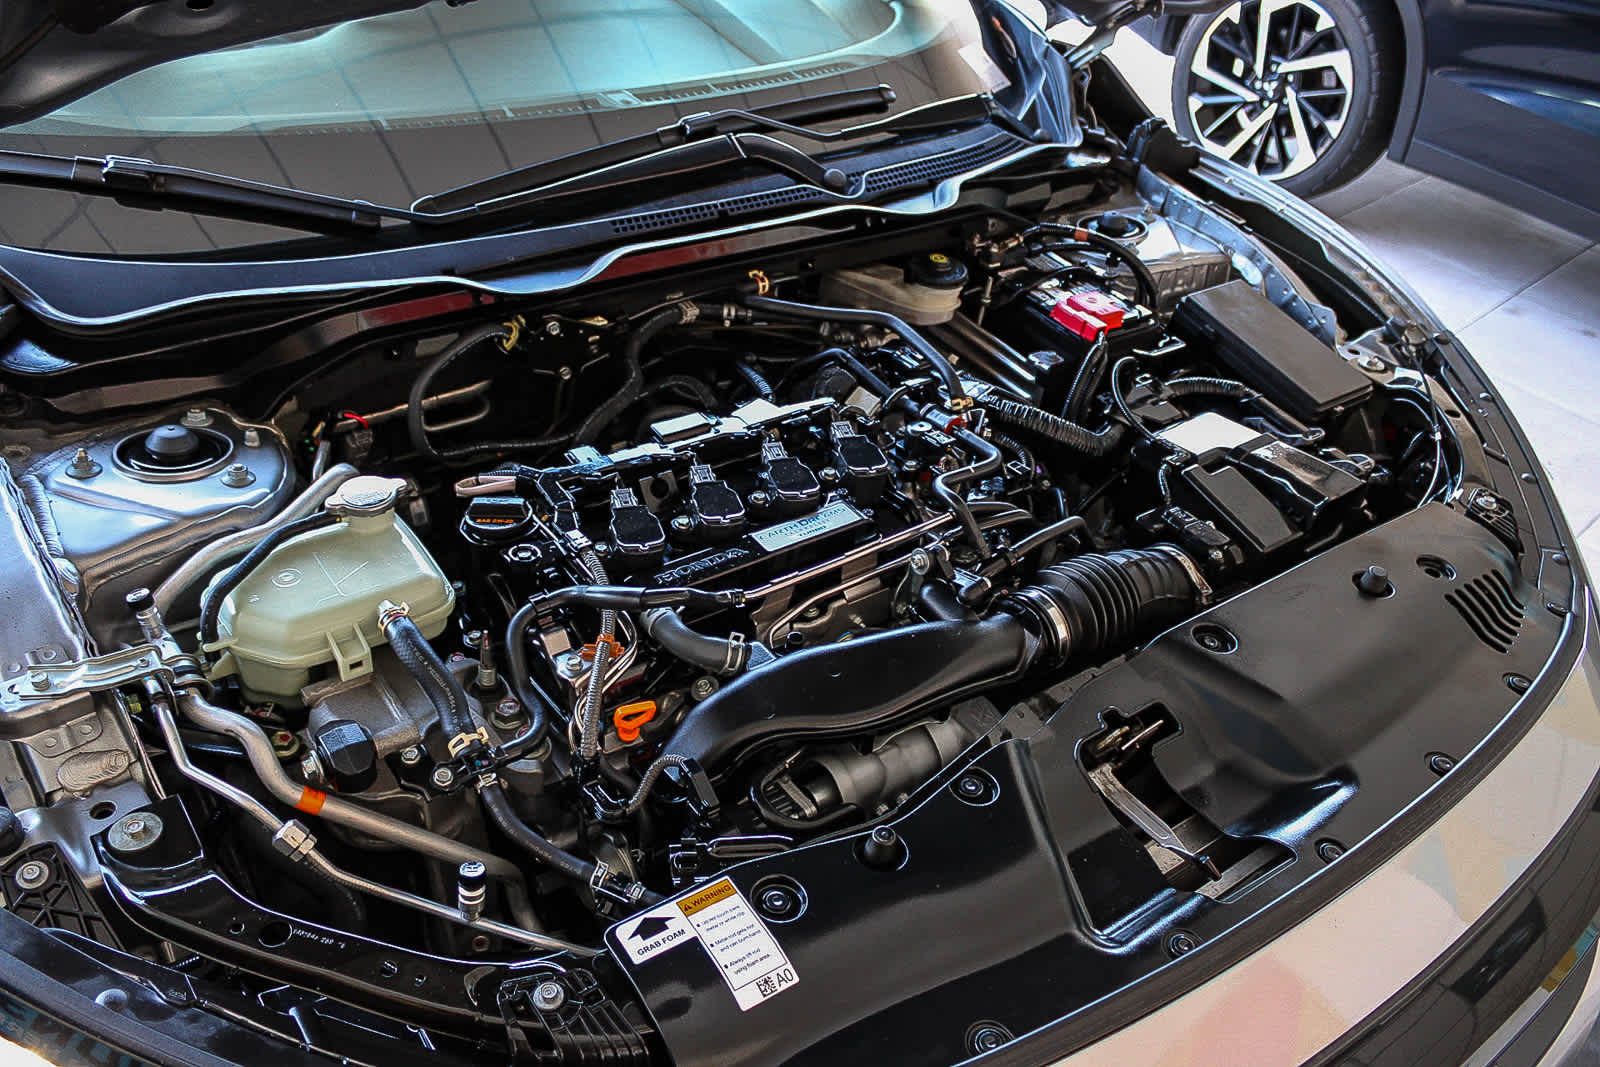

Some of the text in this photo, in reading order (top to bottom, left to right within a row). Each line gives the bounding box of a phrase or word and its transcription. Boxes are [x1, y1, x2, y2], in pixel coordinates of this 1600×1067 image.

[653, 548, 750, 584] HONDA
[691, 885, 731, 907] WARNING
[637, 929, 686, 956] GRAB FOAM
